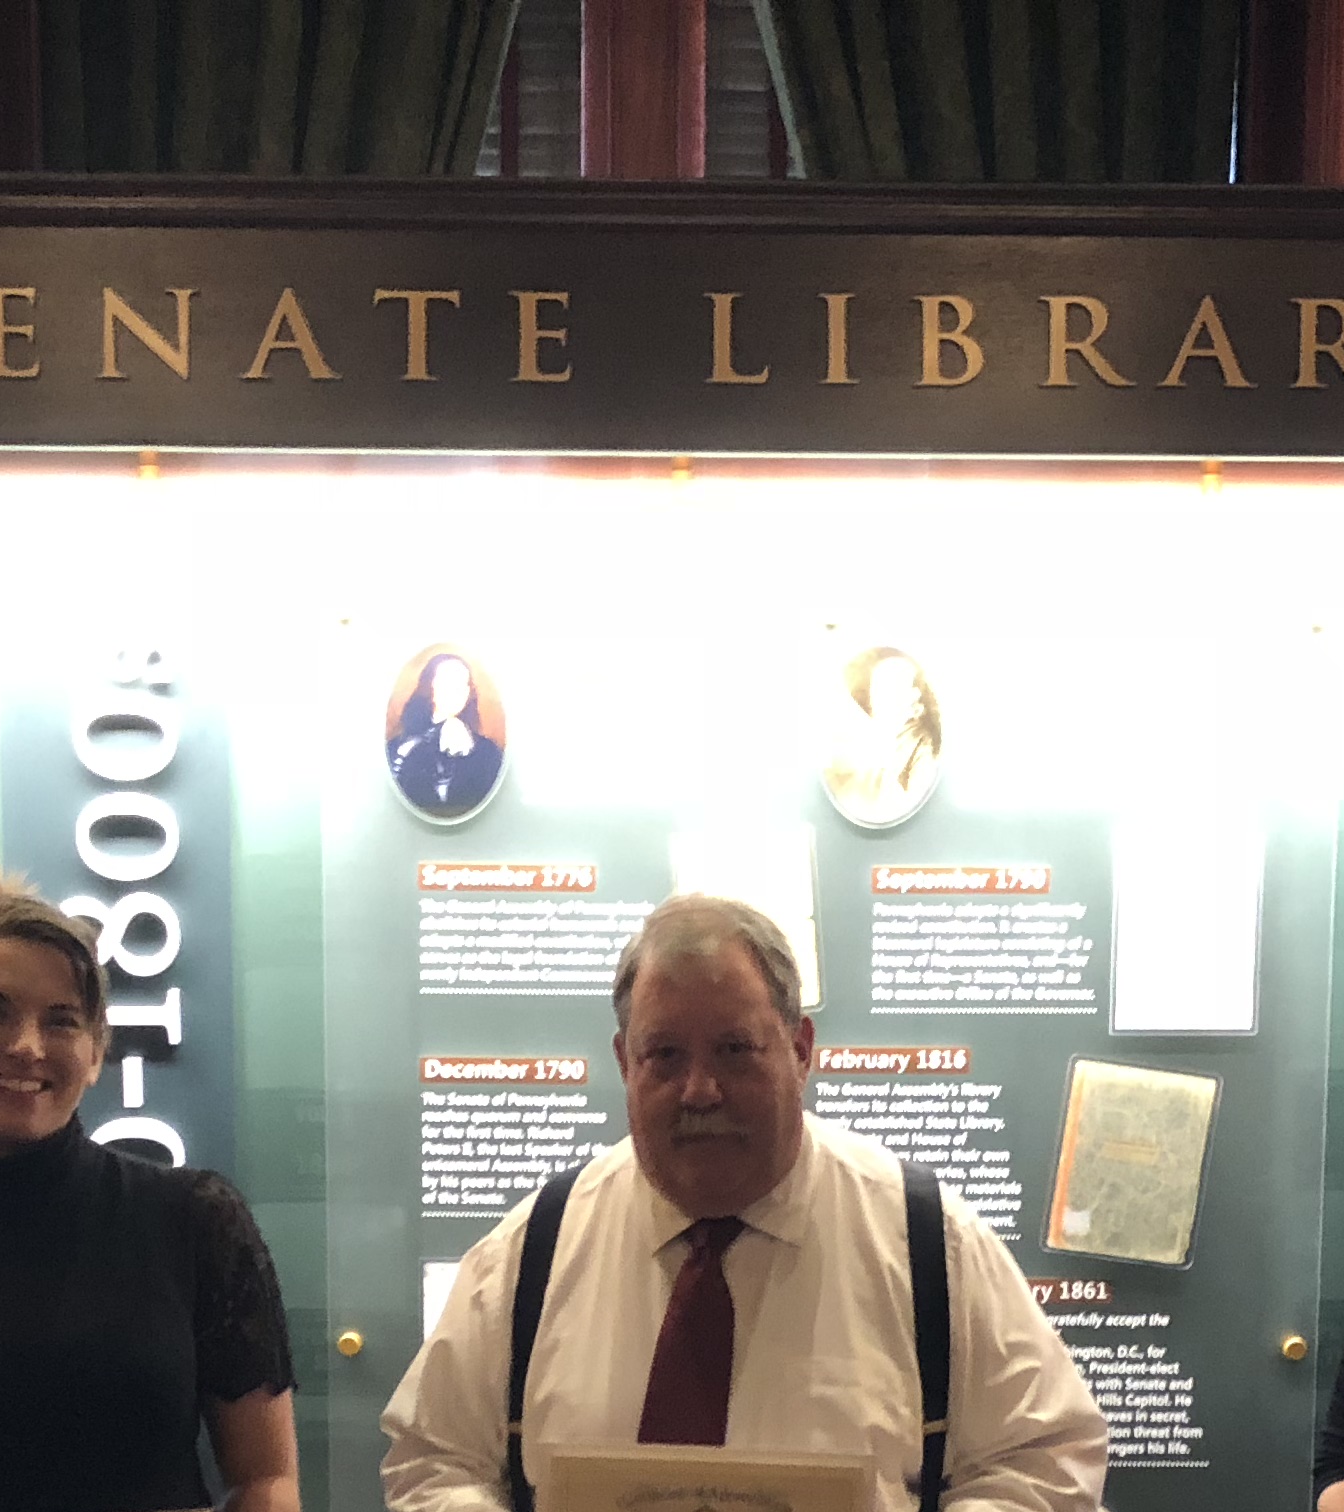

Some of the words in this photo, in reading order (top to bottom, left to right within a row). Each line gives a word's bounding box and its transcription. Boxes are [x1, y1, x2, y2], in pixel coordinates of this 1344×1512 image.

[422, 865, 537, 890] September
[541, 865, 592, 887] 1776
[876, 868, 990, 893] September
[425, 1059, 529, 1079] December
[534, 1060, 584, 1079] 1790
[819, 1049, 910, 1073] February
[916, 1049, 966, 1069] 1816
[1059, 1281, 1107, 1300] 1861
[1106, 1313, 1147, 1329] accept
[1149, 1313, 1169, 1327] the
[1147, 1344, 1167, 1359] for
[1089, 1361, 1179, 1375] President-elect
[1096, 1377, 1123, 1391] with
[1125, 1377, 1166, 1391] Senate
[1168, 1377, 1193, 1391] and
[1175, 1393, 1193, 1407] He
